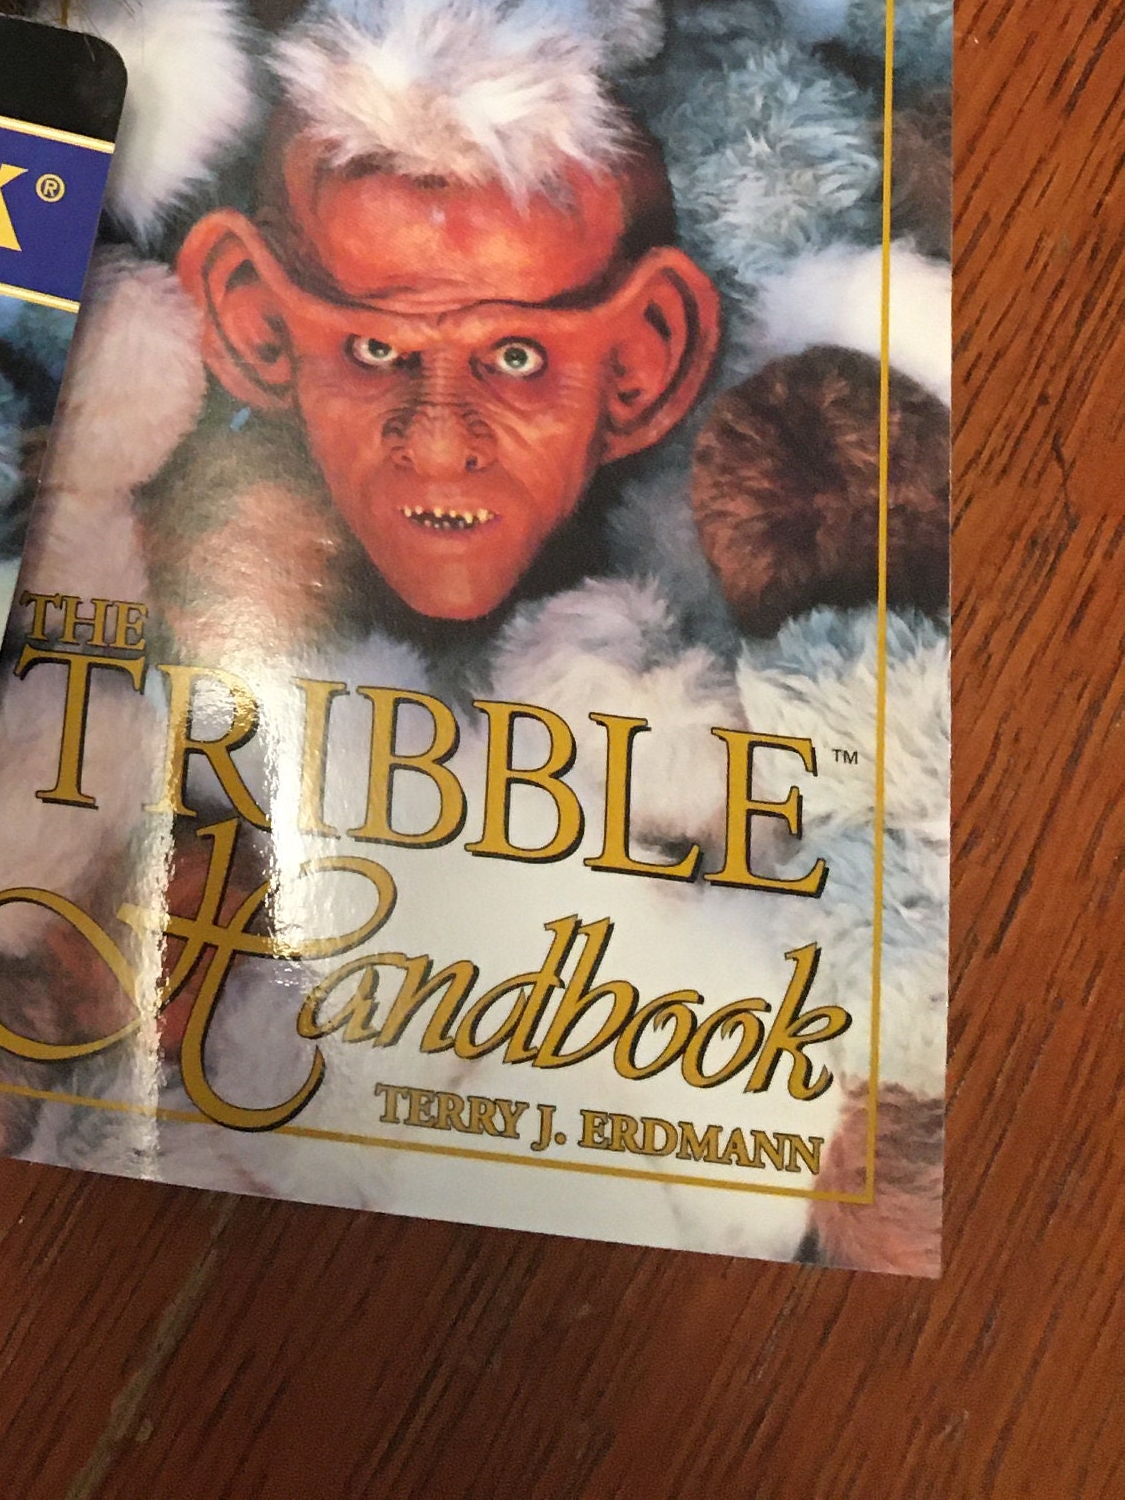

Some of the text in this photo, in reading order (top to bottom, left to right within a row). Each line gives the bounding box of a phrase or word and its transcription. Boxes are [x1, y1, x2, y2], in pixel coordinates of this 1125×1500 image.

[18, 588, 149, 654] THE
[375, 1081, 826, 1175] TERRY J. ERDMANN
